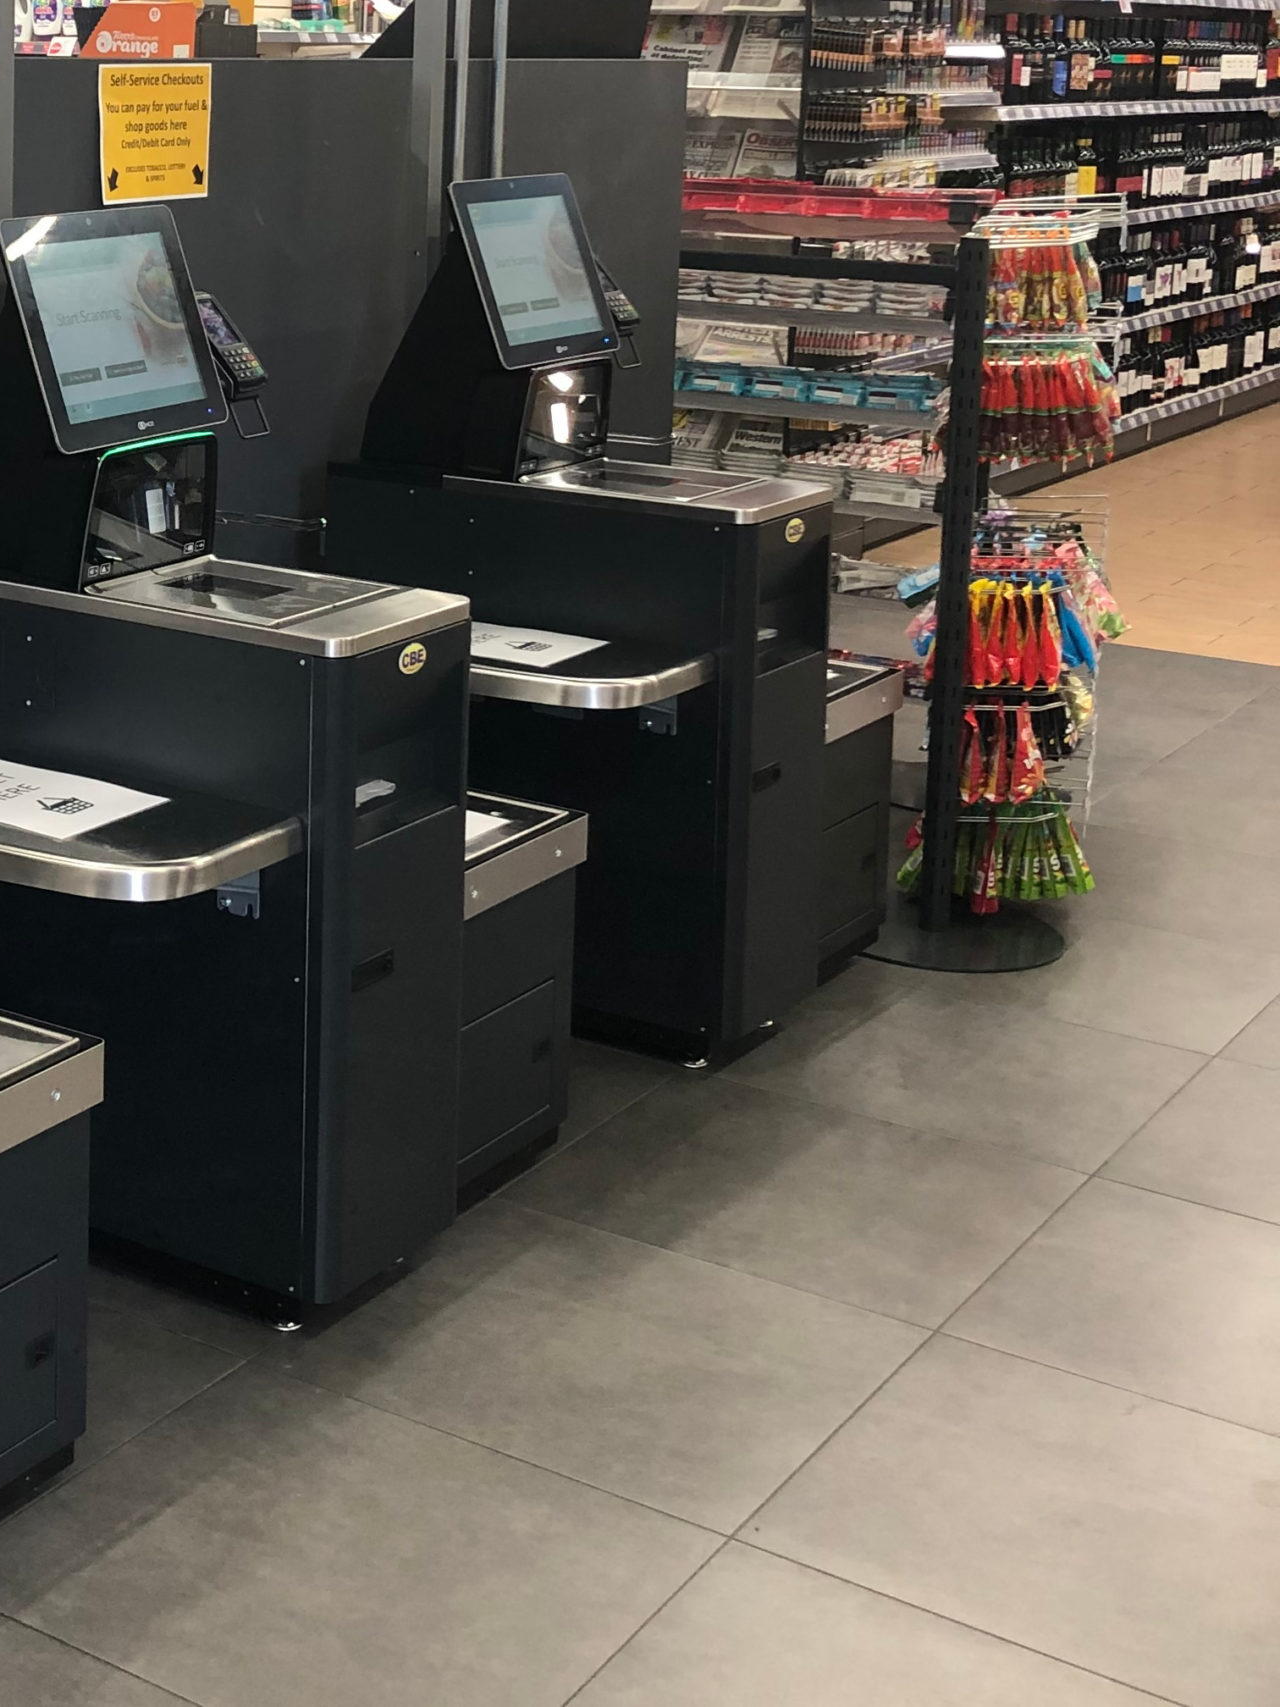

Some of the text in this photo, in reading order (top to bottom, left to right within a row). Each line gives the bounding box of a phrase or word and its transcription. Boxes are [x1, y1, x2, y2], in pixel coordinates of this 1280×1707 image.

[96, 31, 159, 58] Orange
[110, 72, 204, 87] Self-Service Checkouts
[105, 99, 207, 115] You can pay for your fuel &
[125, 119, 187, 134] shop goods here
[121, 136, 191, 150] Credit/Debit Card Only
[402, 648, 424, 668] CBE
